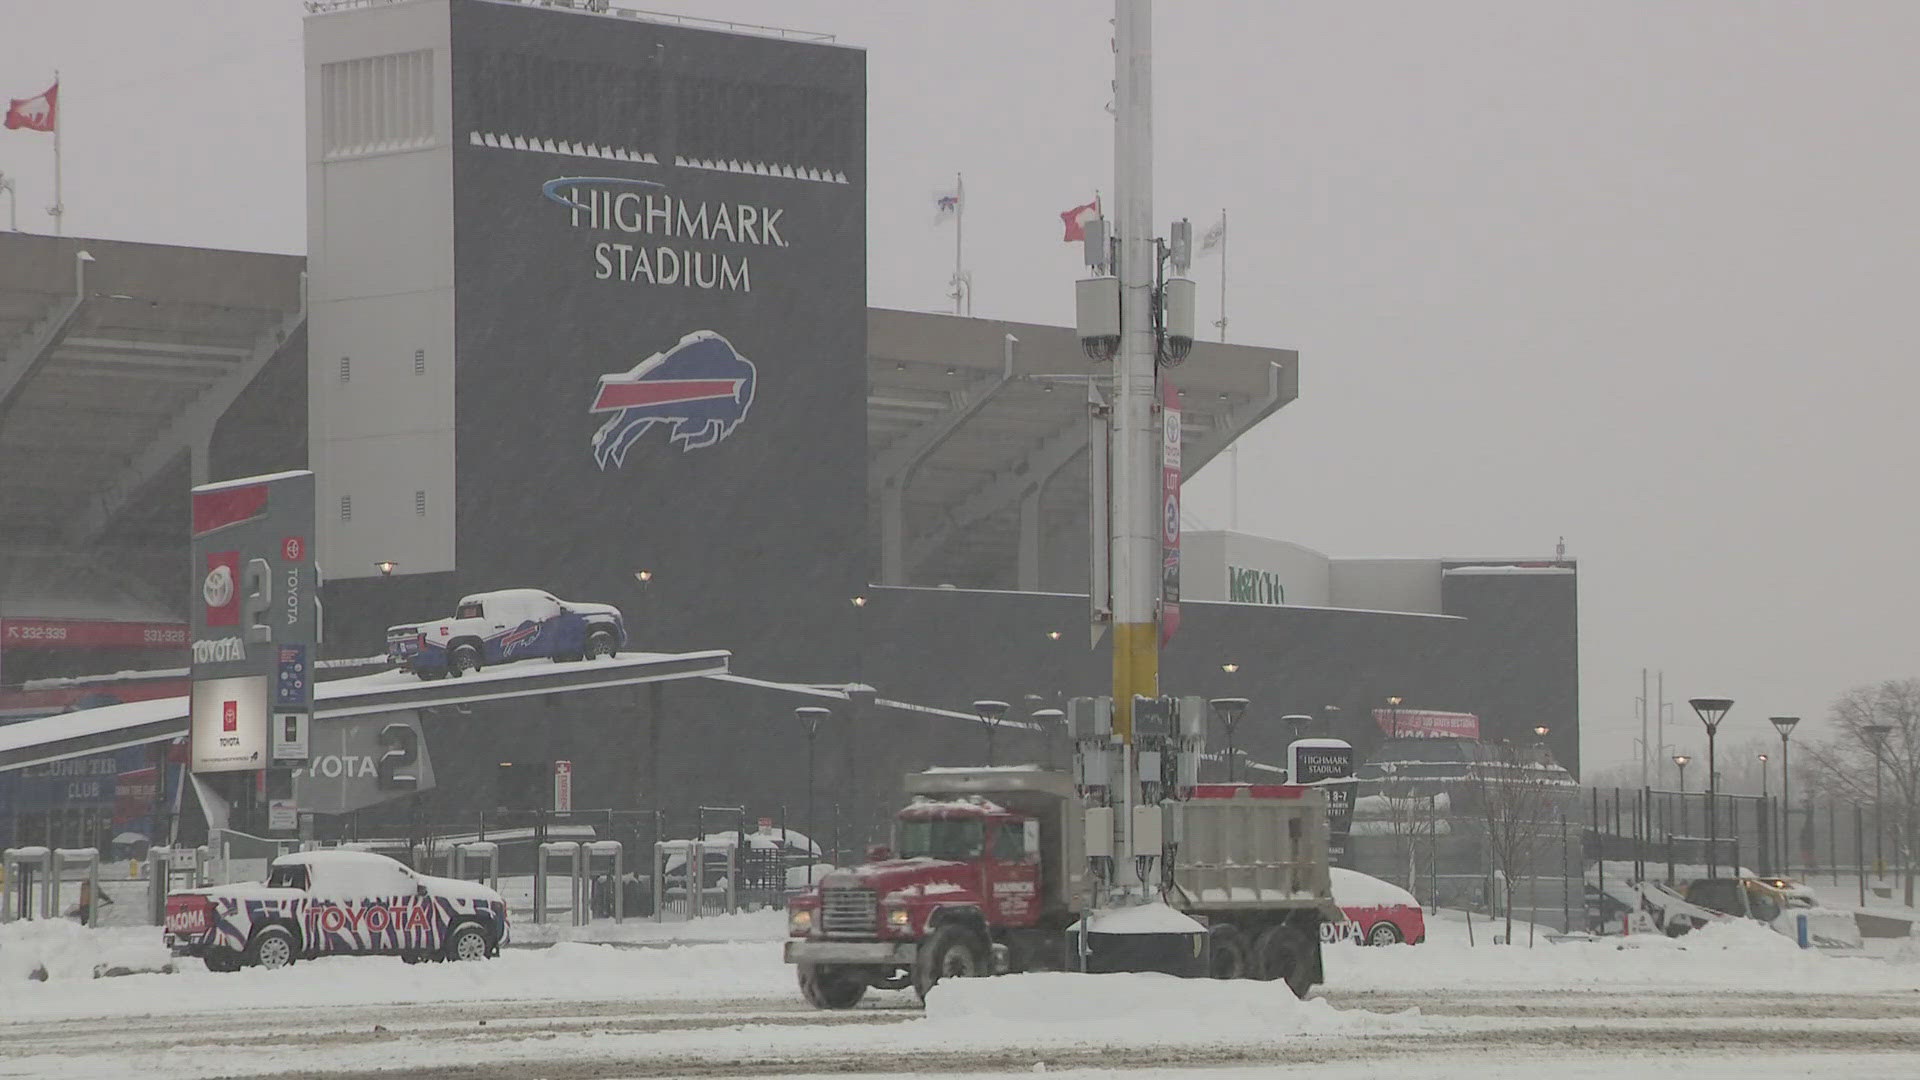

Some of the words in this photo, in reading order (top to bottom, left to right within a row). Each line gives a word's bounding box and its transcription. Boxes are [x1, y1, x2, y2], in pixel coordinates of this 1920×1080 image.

[595, 242, 750, 292] STADIUM
[246, 558, 272, 643] 2
[287, 568, 298, 625] TOYOTA
[192, 637, 246, 664] TOYOTA
[219, 737, 240, 748] TOYOTA
[292, 754, 378, 778] YOTA
[1304, 755, 1348, 765] HIGHMARK
[1308, 765, 1341, 774] STADIUM
[68, 782, 100, 799] CLUB
[166, 909, 206, 930] TACOMA
[305, 905, 430, 933] TOYOTA
